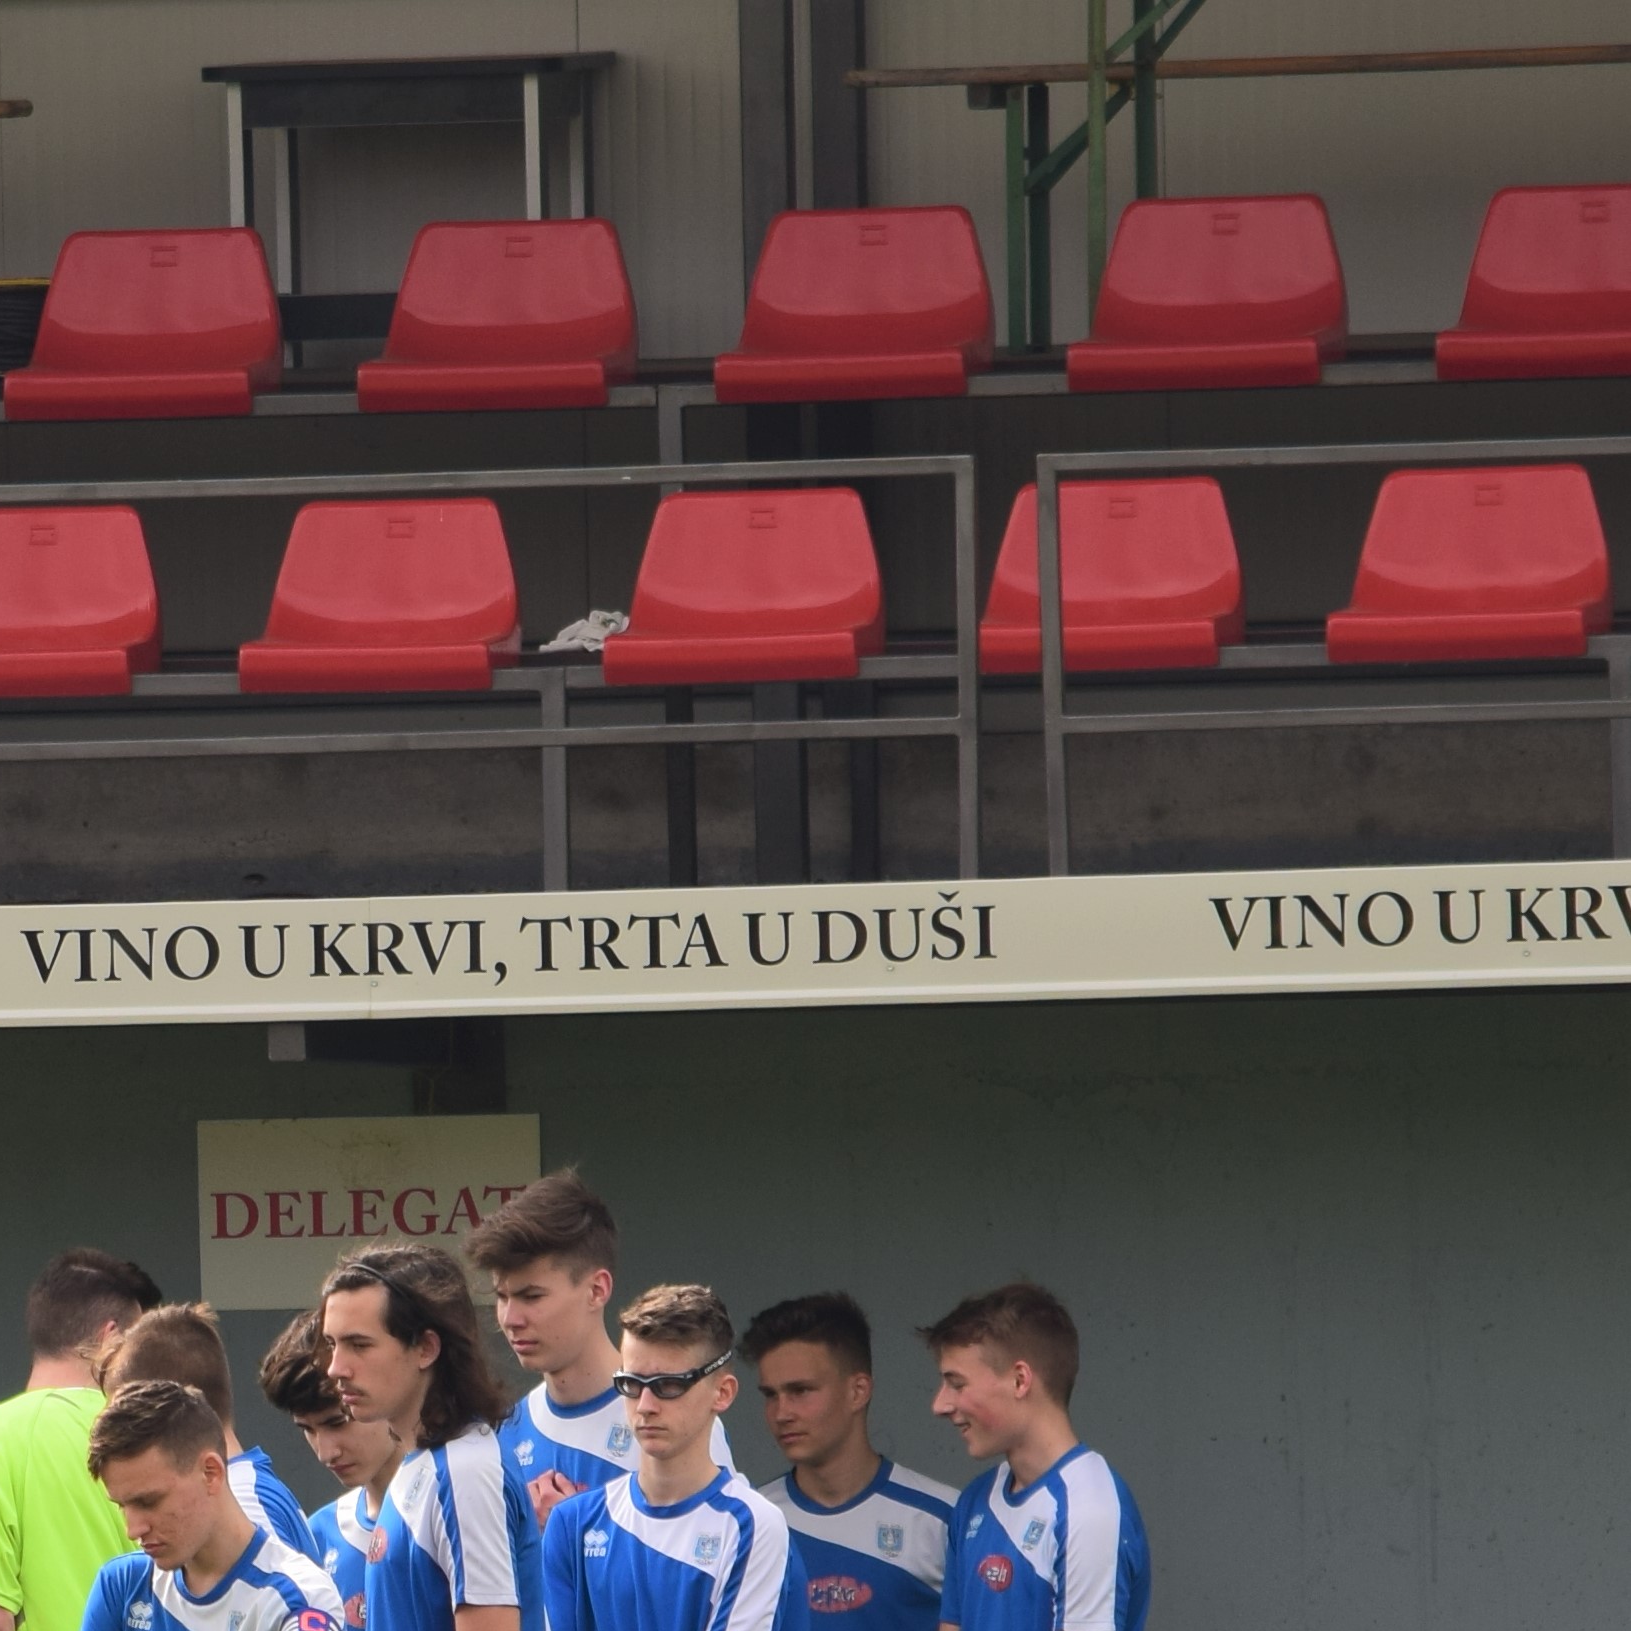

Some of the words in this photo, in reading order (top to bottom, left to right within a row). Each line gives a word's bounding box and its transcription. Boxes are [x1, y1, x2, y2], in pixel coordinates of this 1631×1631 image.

[19, 925, 220, 984] VINO
[238, 924, 291, 979] U
[309, 920, 508, 986] KRVI,
[519, 912, 729, 972] TRTA
[742, 911, 795, 966] U
[811, 891, 997, 964] DUŠI
[1208, 891, 1414, 952] VINO
[1432, 889, 1486, 945] U
